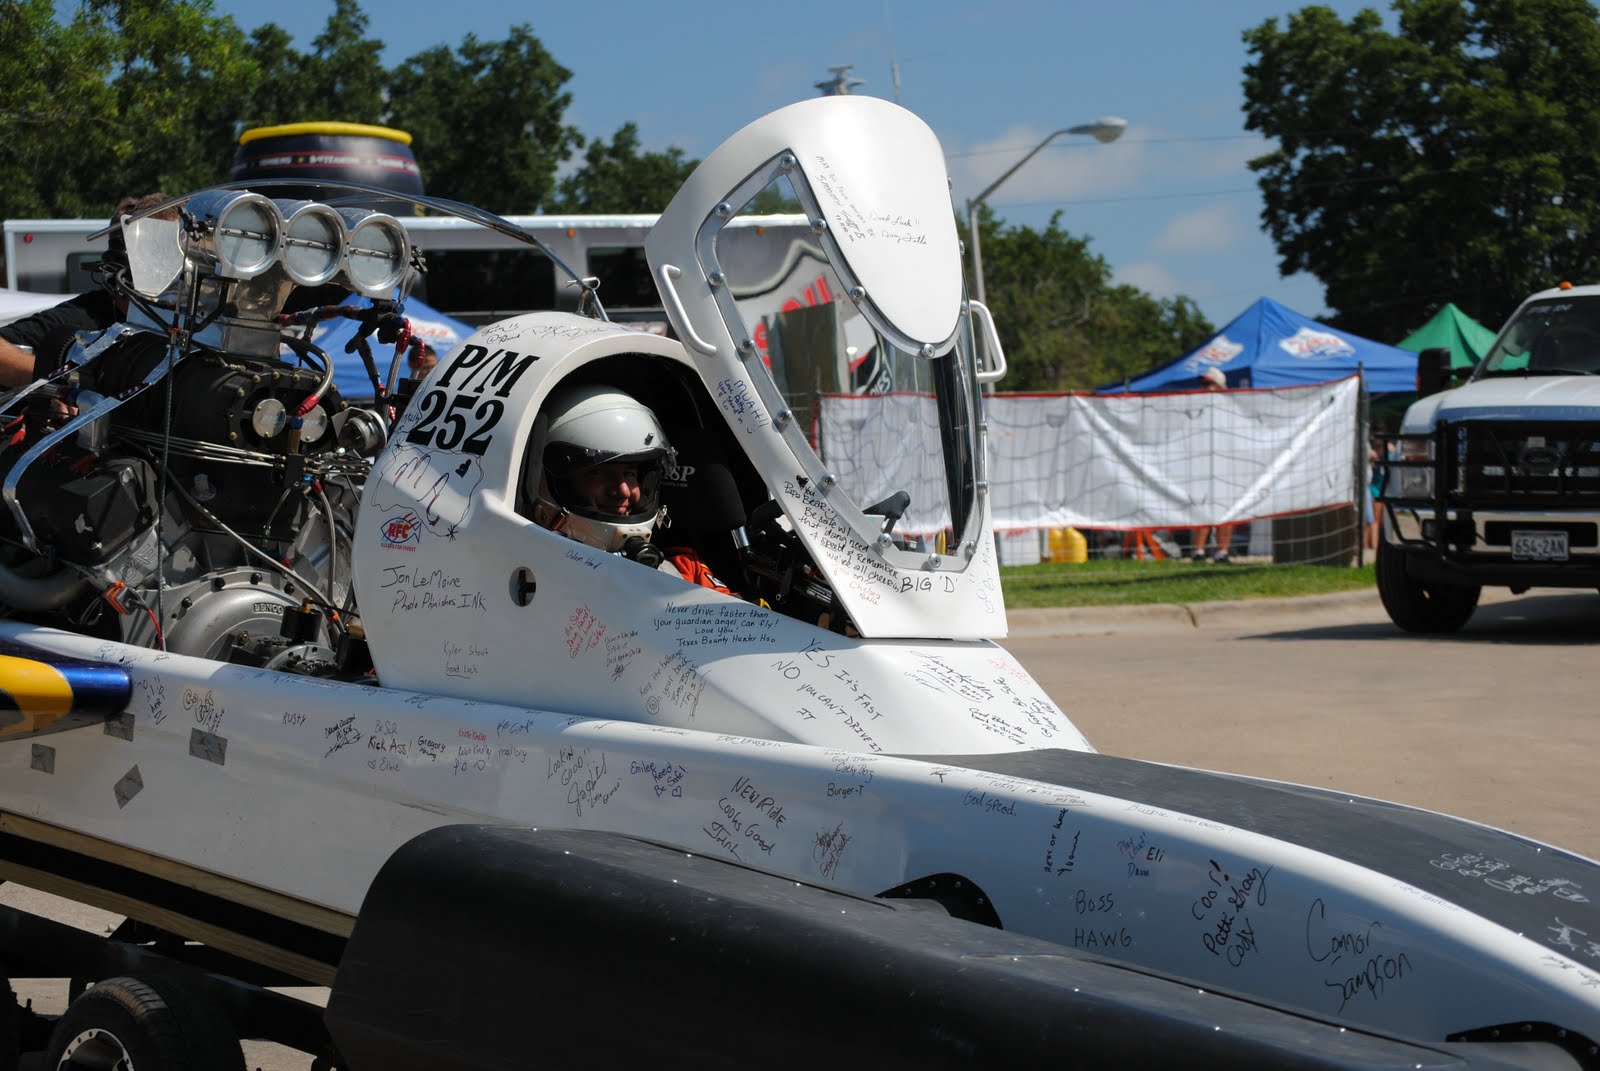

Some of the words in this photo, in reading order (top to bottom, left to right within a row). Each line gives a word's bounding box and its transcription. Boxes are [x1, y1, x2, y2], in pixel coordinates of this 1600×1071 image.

[436, 344, 541, 398] P/M
[406, 389, 504, 456] 252
[900, 576, 932, 593] BIG
[665, 601, 688, 614] Never
[692, 604, 714, 616] drive
[719, 606, 747, 618] faster
[750, 609, 768, 618] than
[675, 617, 711, 630] guardian
[798, 638, 835, 668] YES
[854, 693, 883, 720] FAST
[771, 660, 800, 679] NO
[844, 716, 873, 742] DRIVE
[1146, 846, 1166, 862] Eli
[1074, 926, 1133, 948] HAWG
